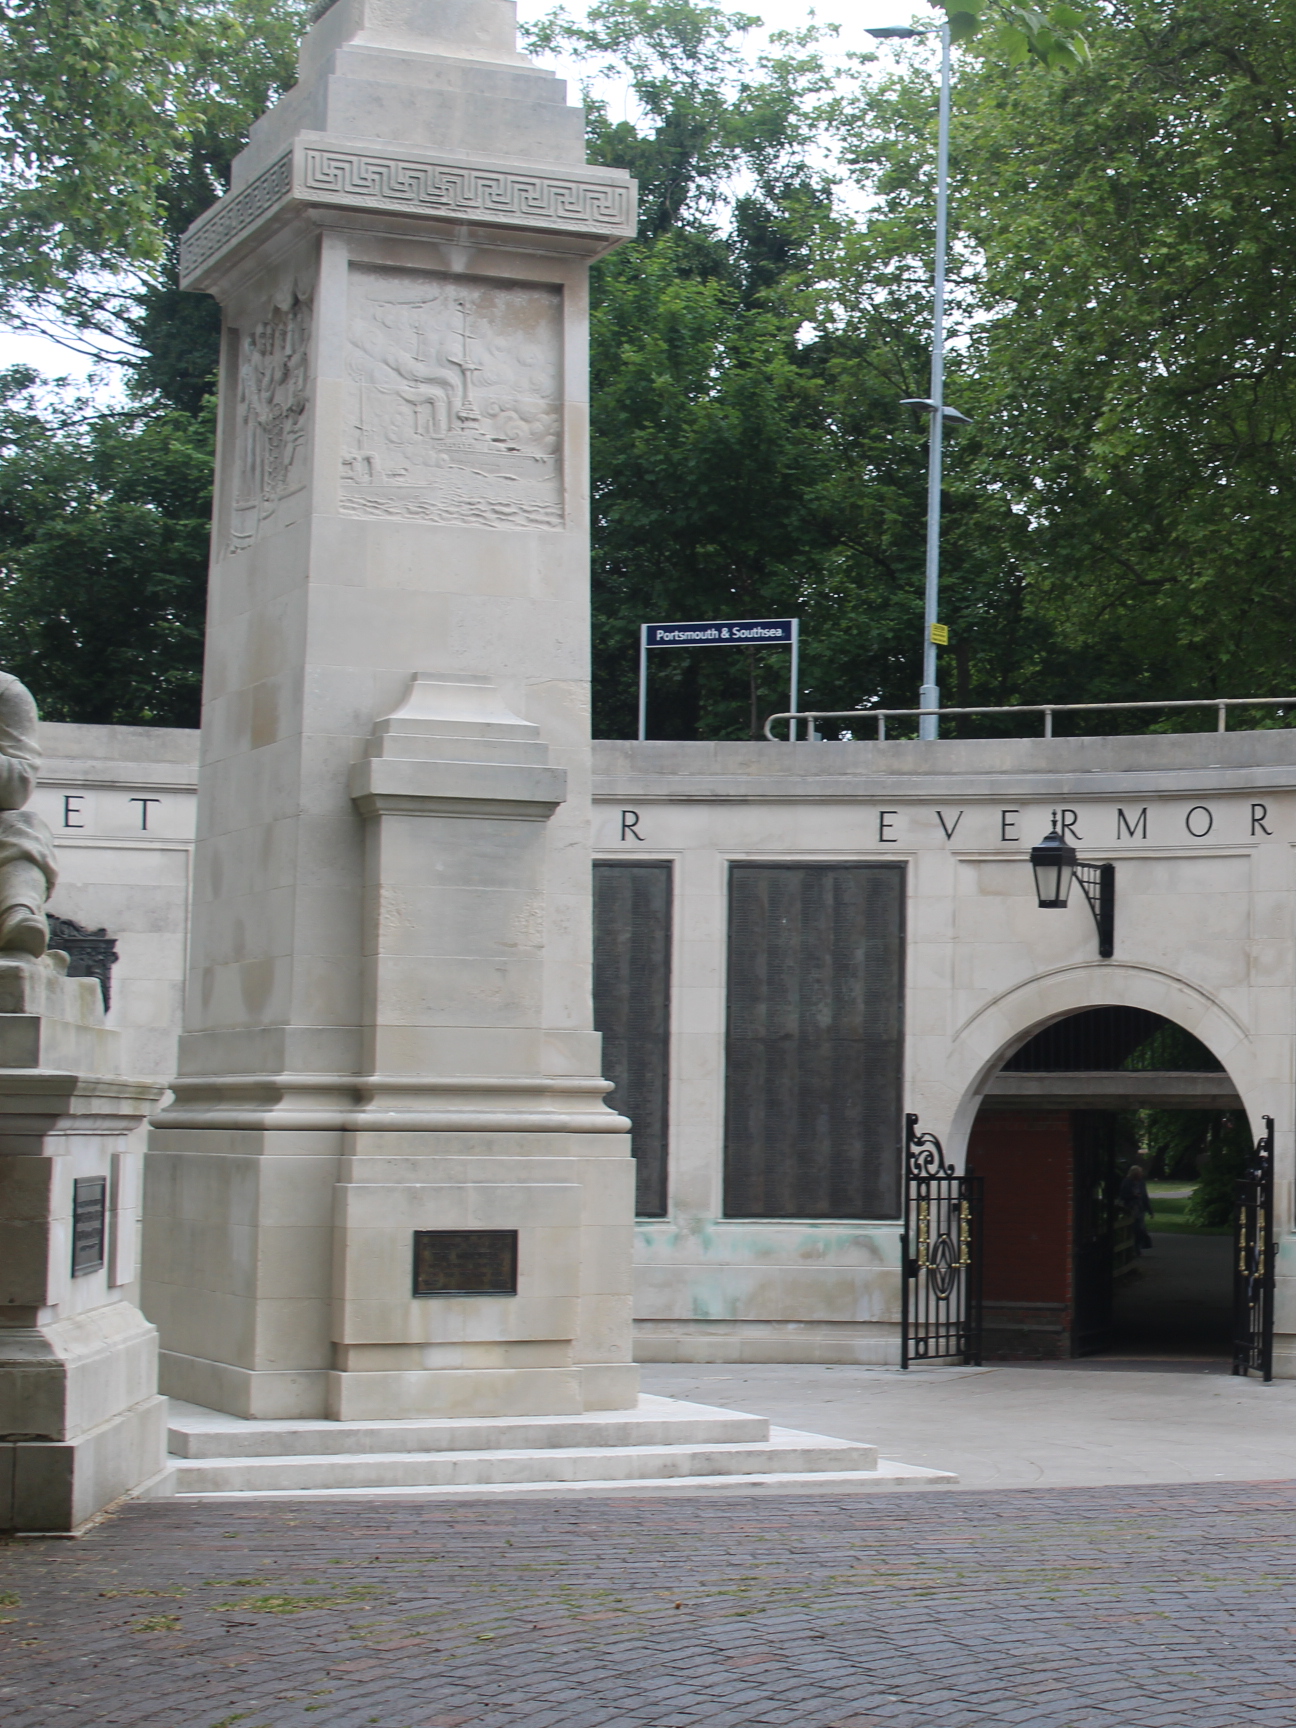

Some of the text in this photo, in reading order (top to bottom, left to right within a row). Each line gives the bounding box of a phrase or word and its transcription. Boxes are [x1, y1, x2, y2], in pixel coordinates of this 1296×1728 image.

[656, 627, 783, 641] Portsmouth & Southsea
